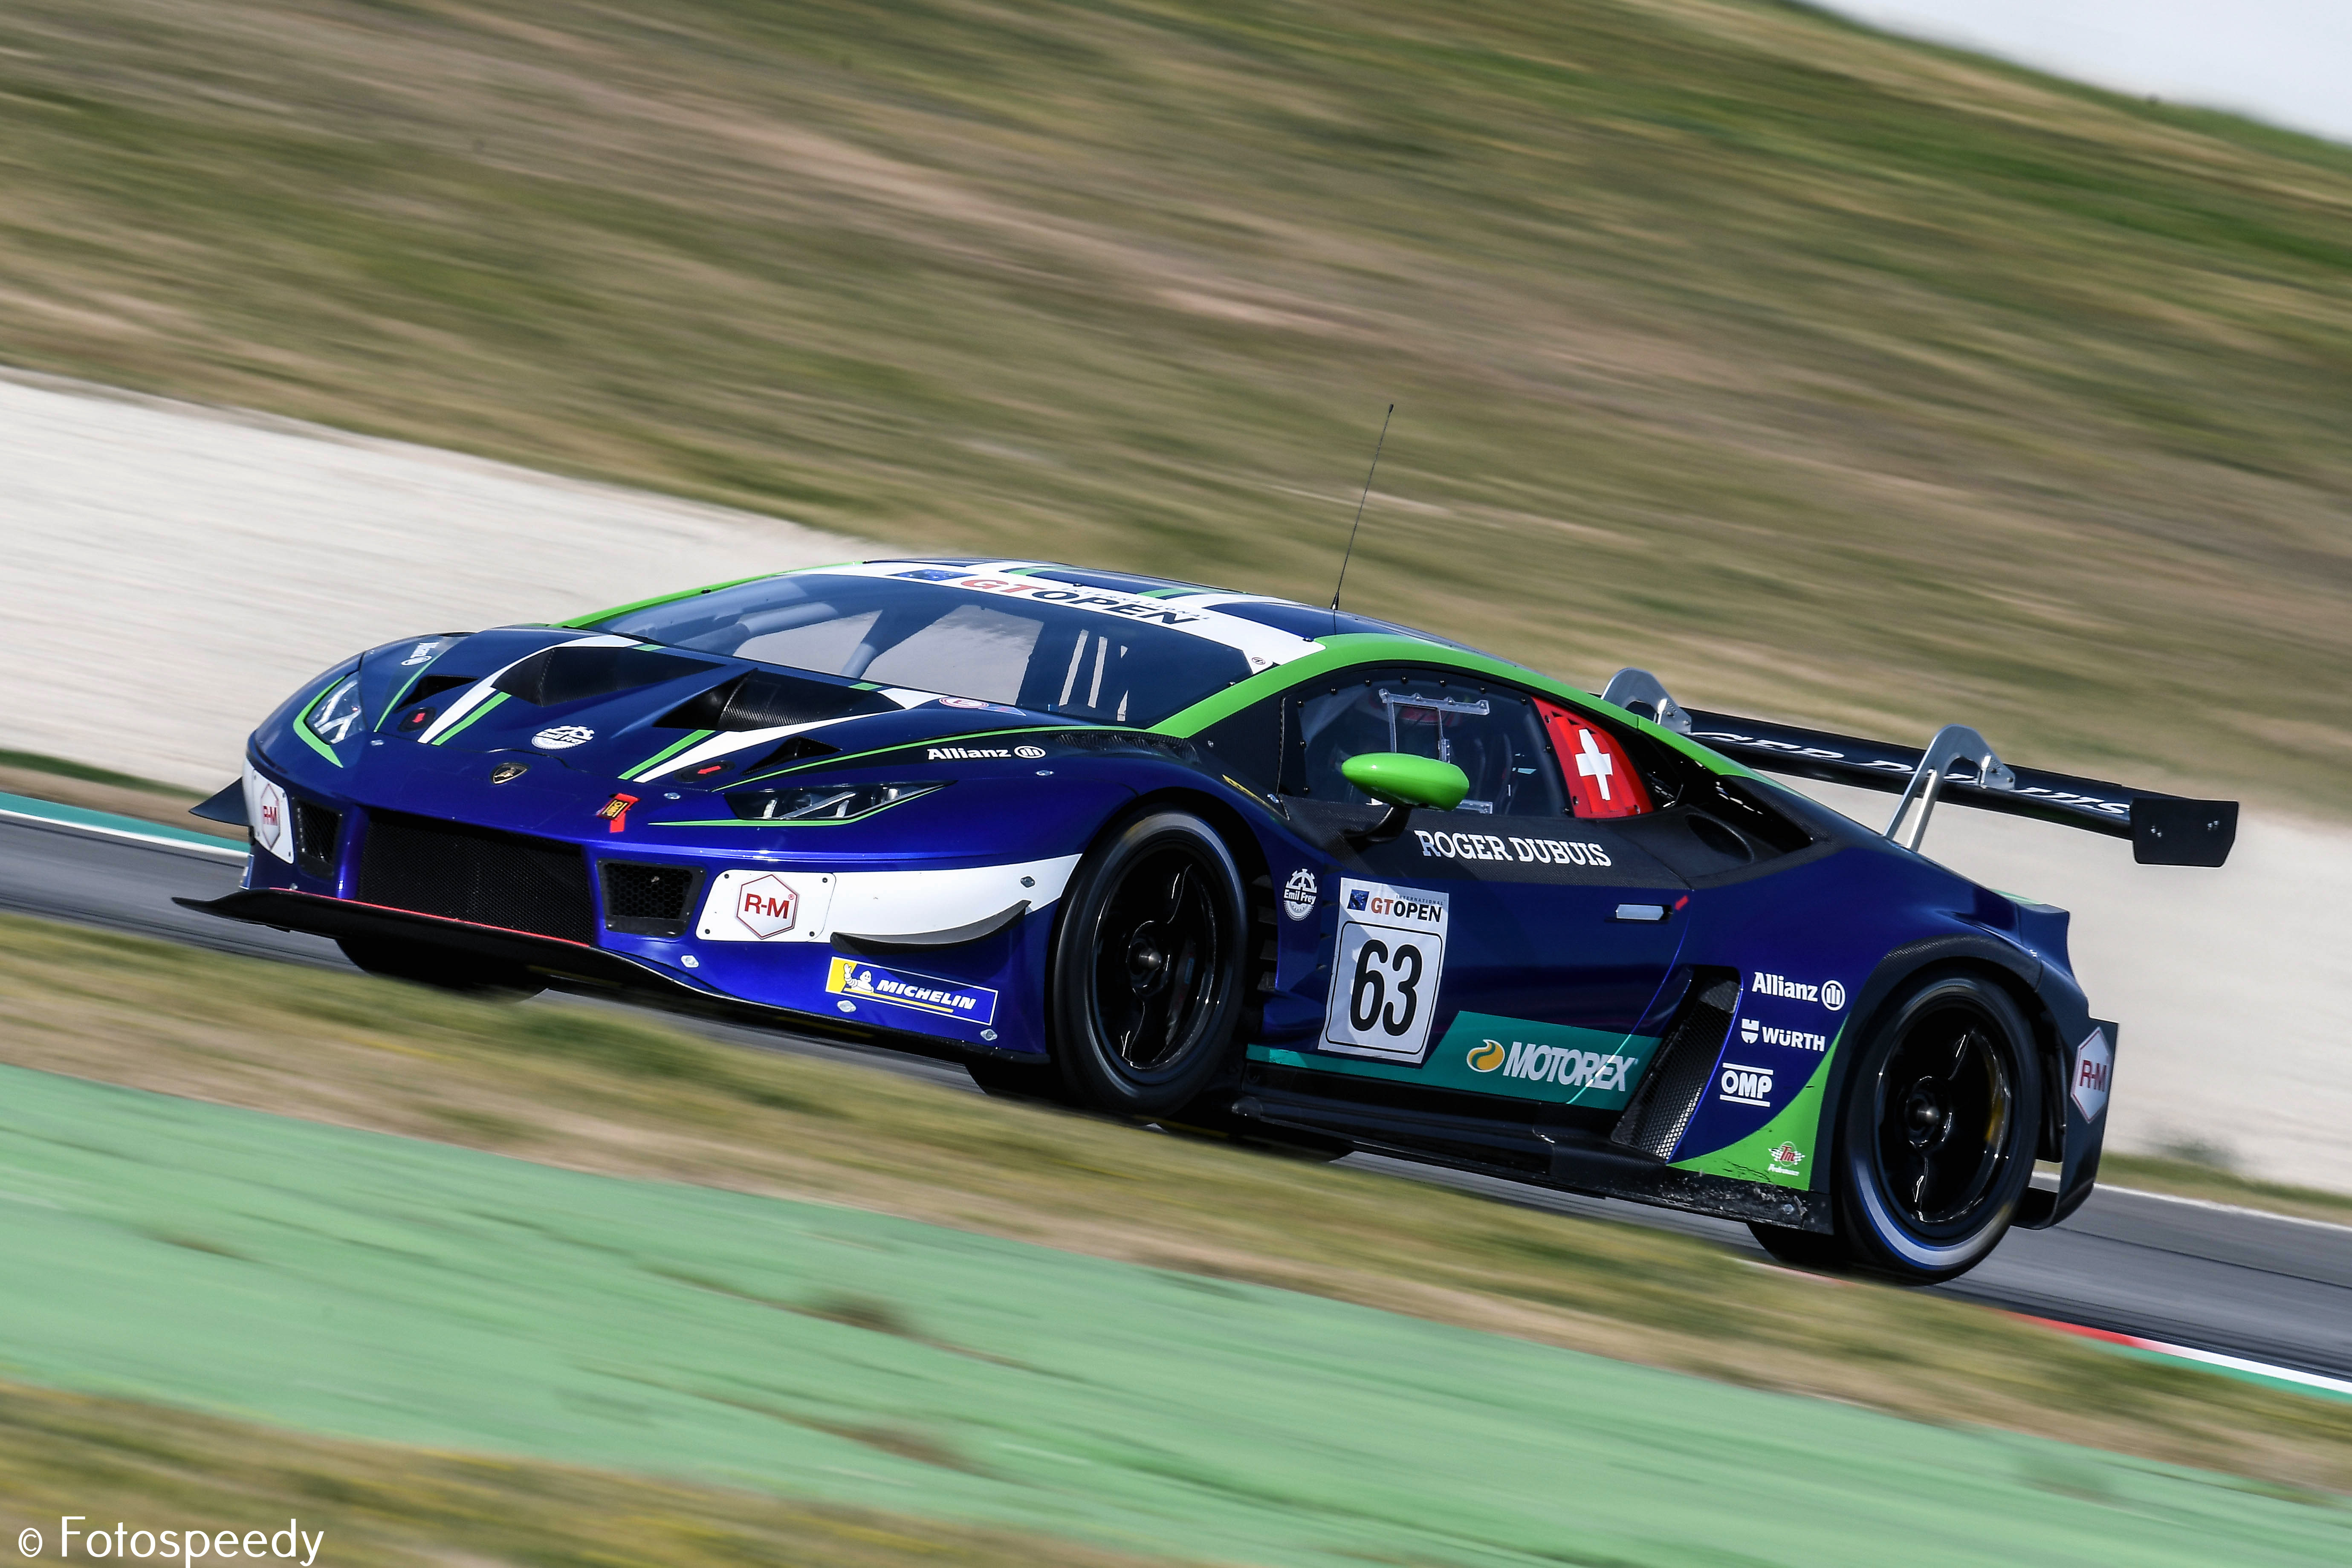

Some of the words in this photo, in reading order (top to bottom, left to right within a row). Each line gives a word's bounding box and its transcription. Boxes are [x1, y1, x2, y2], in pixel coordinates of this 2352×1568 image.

[1062, 587, 1211, 620] INTERNATIONAL
[927, 748, 1012, 760] Allianz
[1414, 830, 1513, 862] ROGER
[1508, 836, 1612, 867] DUBUIS
[1284, 889, 1300, 900] Emil
[1300, 892, 1316, 905] Frey
[1396, 894, 1444, 906] INTERNATIONAL
[877, 979, 976, 1010] MICHELIN
[1350, 939, 1422, 1036] 63
[1752, 972, 1818, 1002] Allianz
[1502, 1041, 1637, 1092] MOTOREX
[1721, 1070, 1772, 1099] OMP
